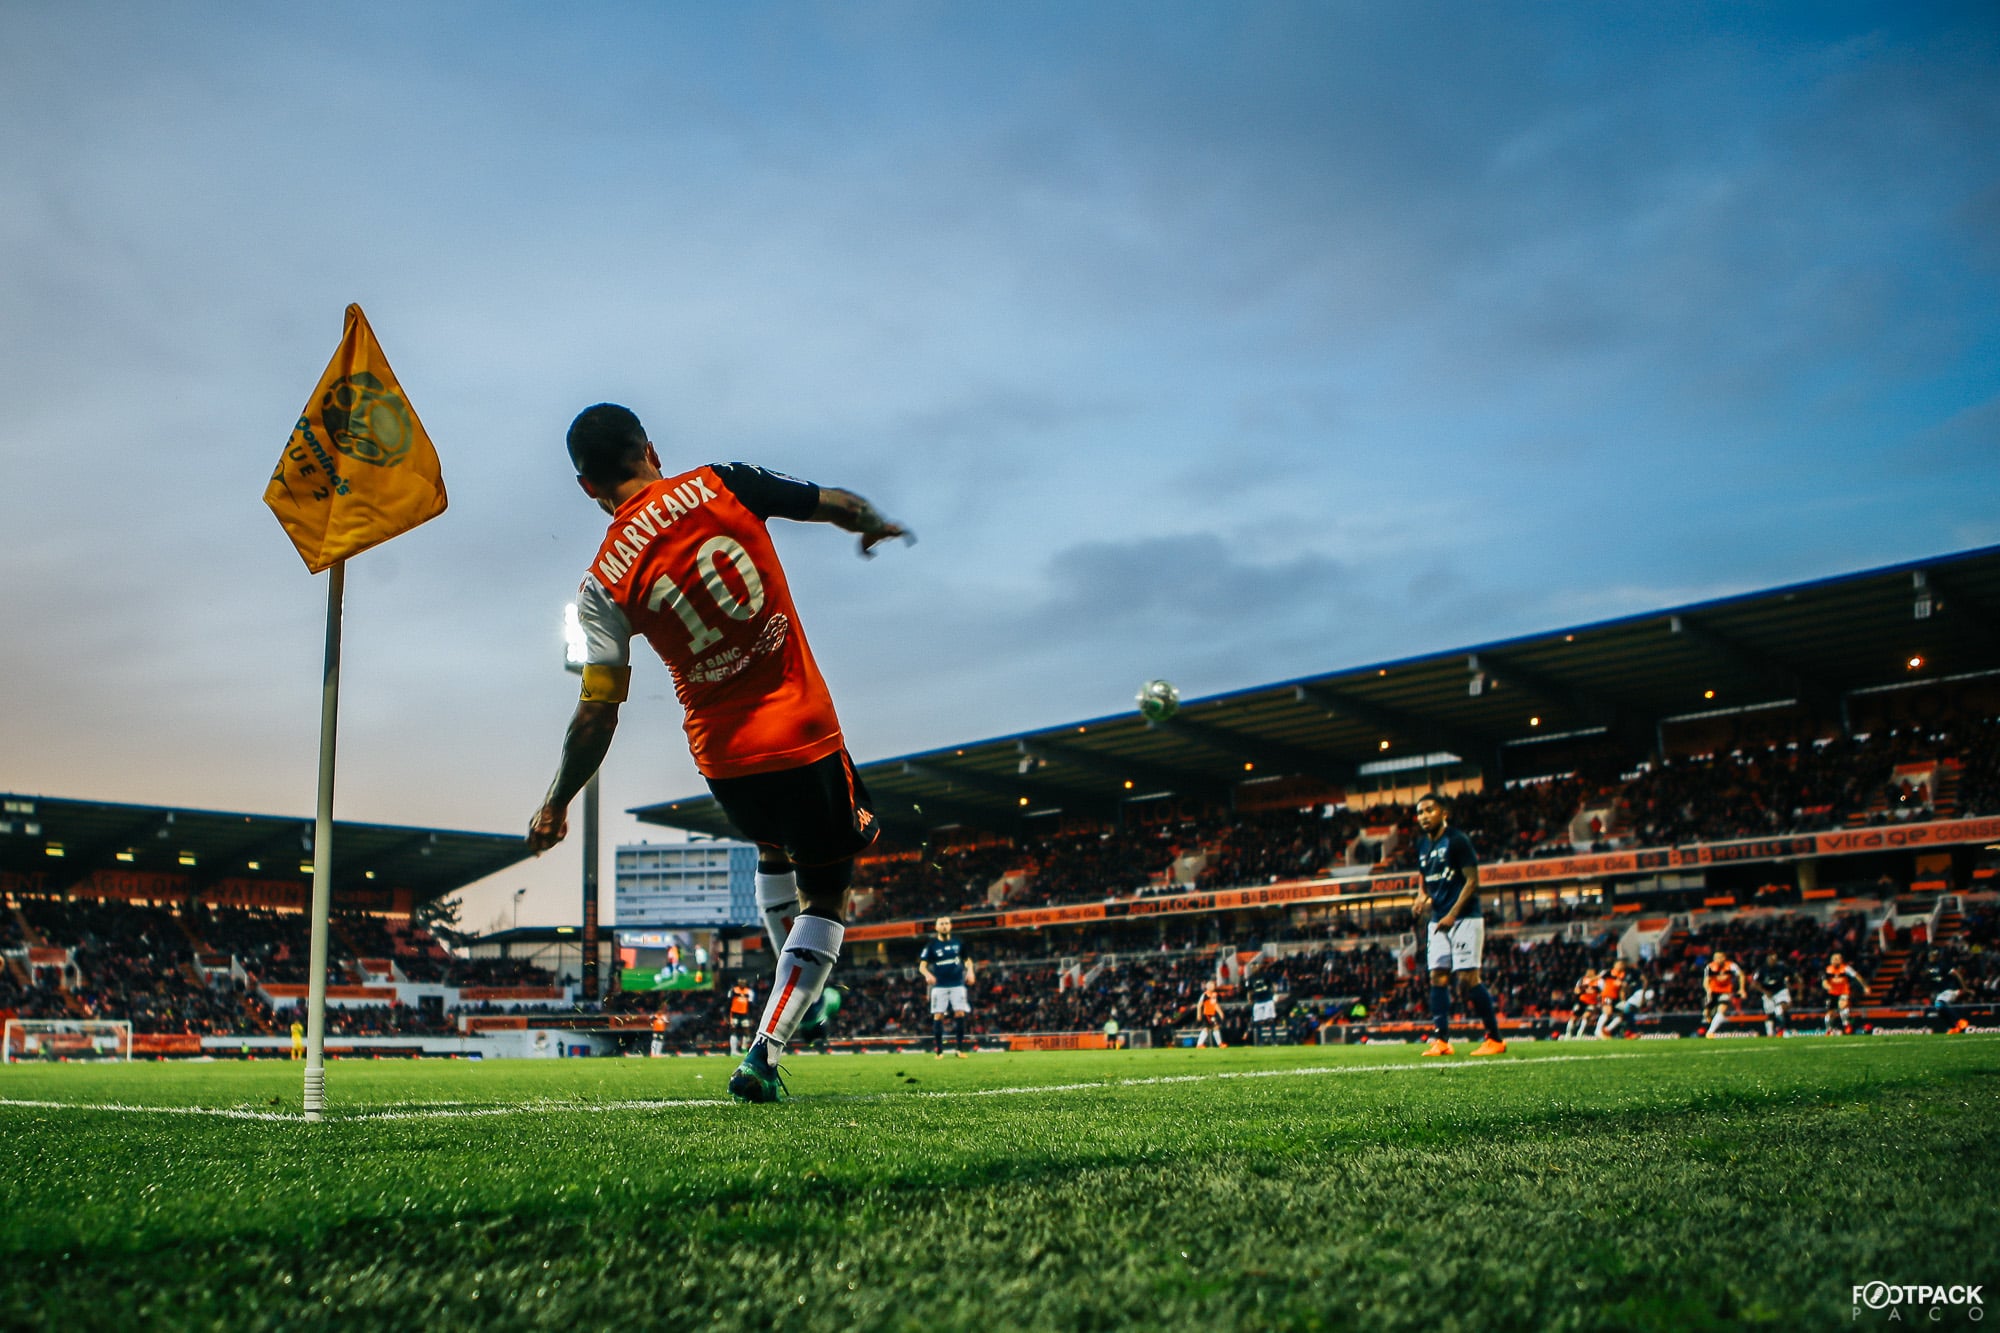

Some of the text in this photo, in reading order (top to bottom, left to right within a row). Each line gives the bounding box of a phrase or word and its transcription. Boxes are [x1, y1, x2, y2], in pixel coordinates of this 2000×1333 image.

[295, 416, 351, 495] Domino's
[312, 486, 329, 501] 2
[598, 476, 717, 585] MARVEAUX
[648, 535, 764, 655] 10
[705, 647, 742, 669] BANC
[1824, 828, 1927, 849] virage
[1715, 842, 1782, 859] HOTELS
[1271, 887, 1312, 901] HOTELS
[1872, 1025, 1933, 1036] Domino's
